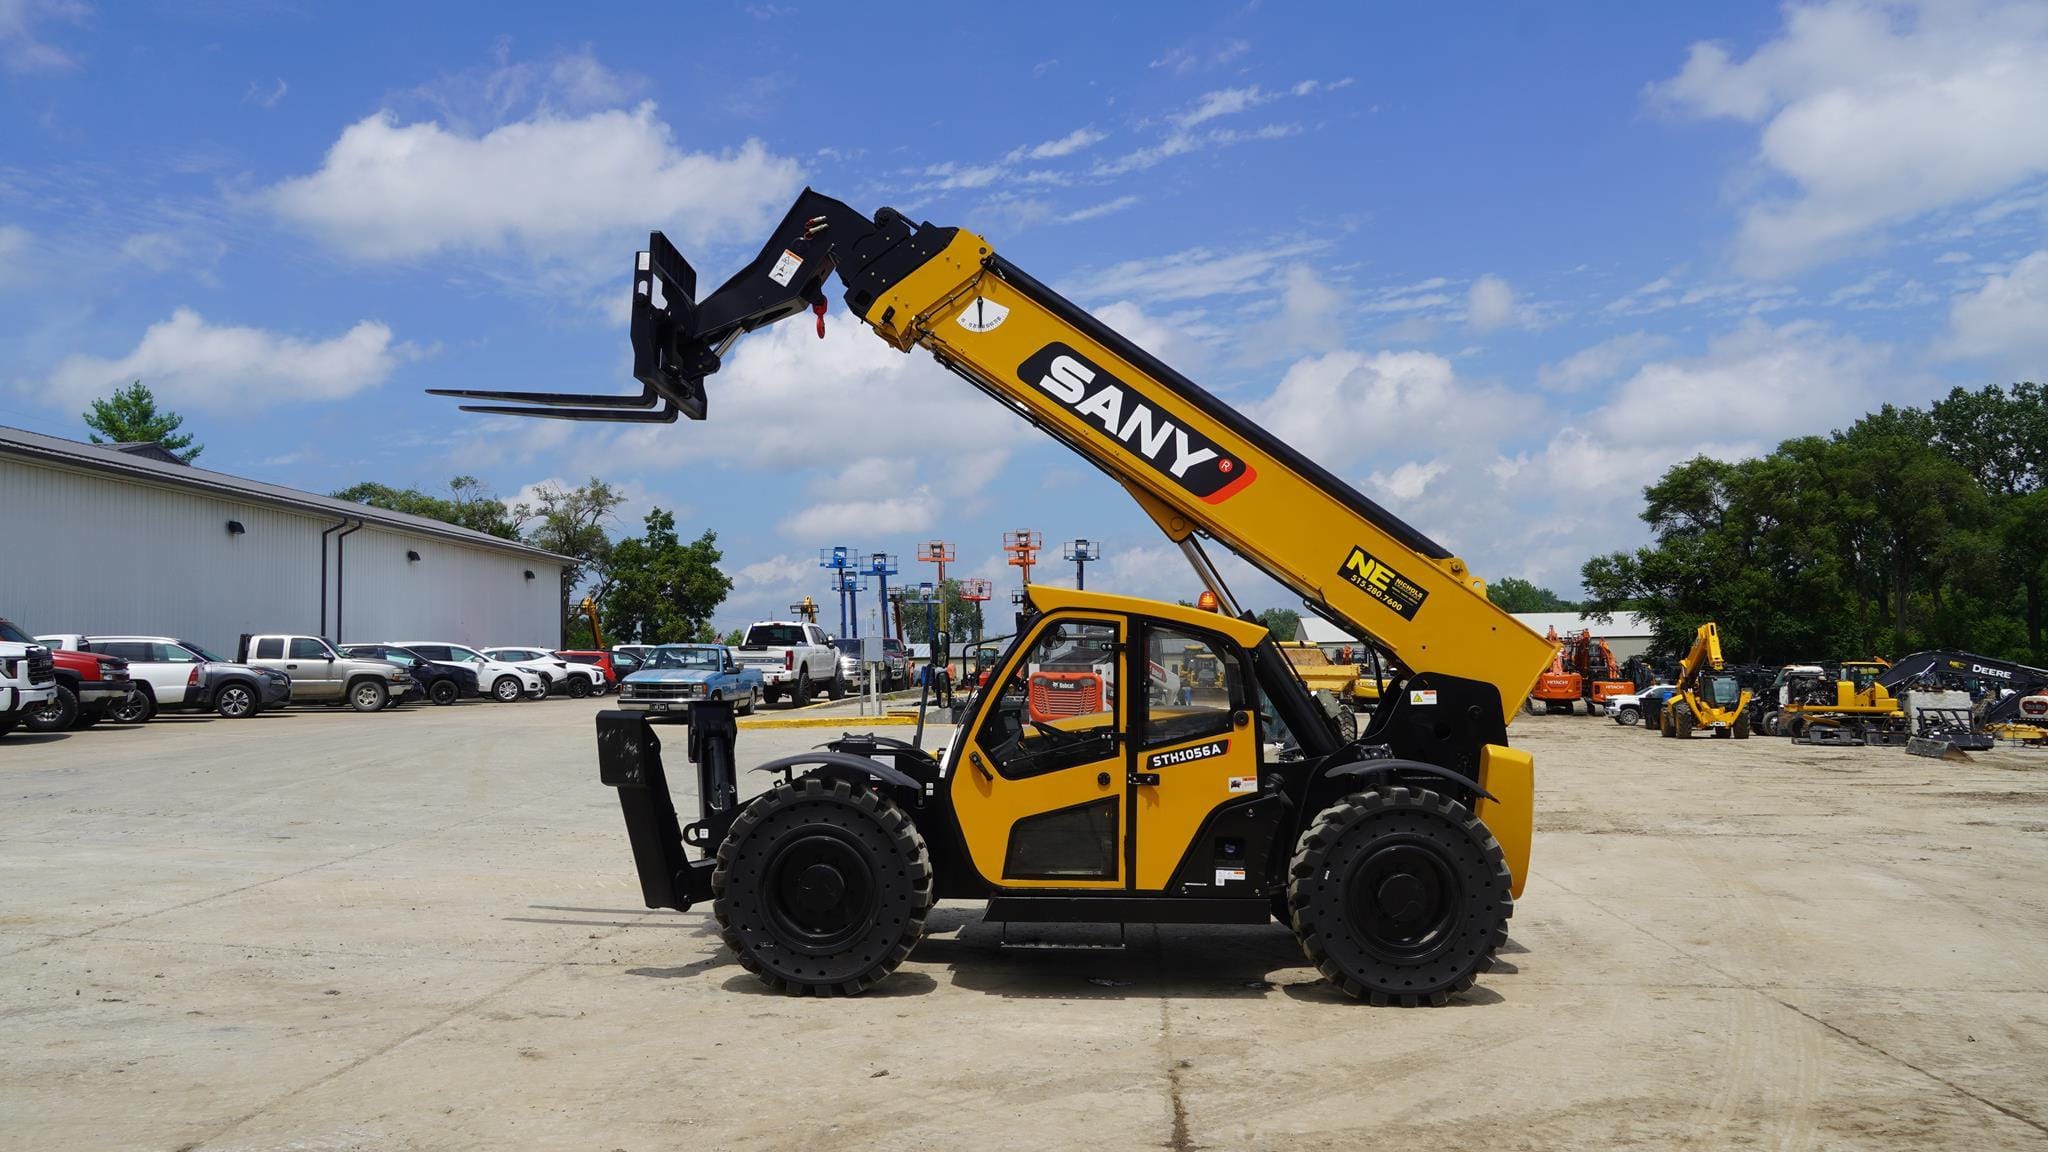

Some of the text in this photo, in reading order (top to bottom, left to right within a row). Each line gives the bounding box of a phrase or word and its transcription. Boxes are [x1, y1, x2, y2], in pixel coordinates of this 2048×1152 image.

[1039, 355, 1219, 478] SANY
[1346, 549, 1396, 592] NE
[1350, 574, 1403, 611] 515.280.7600
[1395, 578, 1424, 599] NICHOLS
[1972, 663, 2012, 679] DEERE
[1152, 743, 1221, 767] STH1056A
